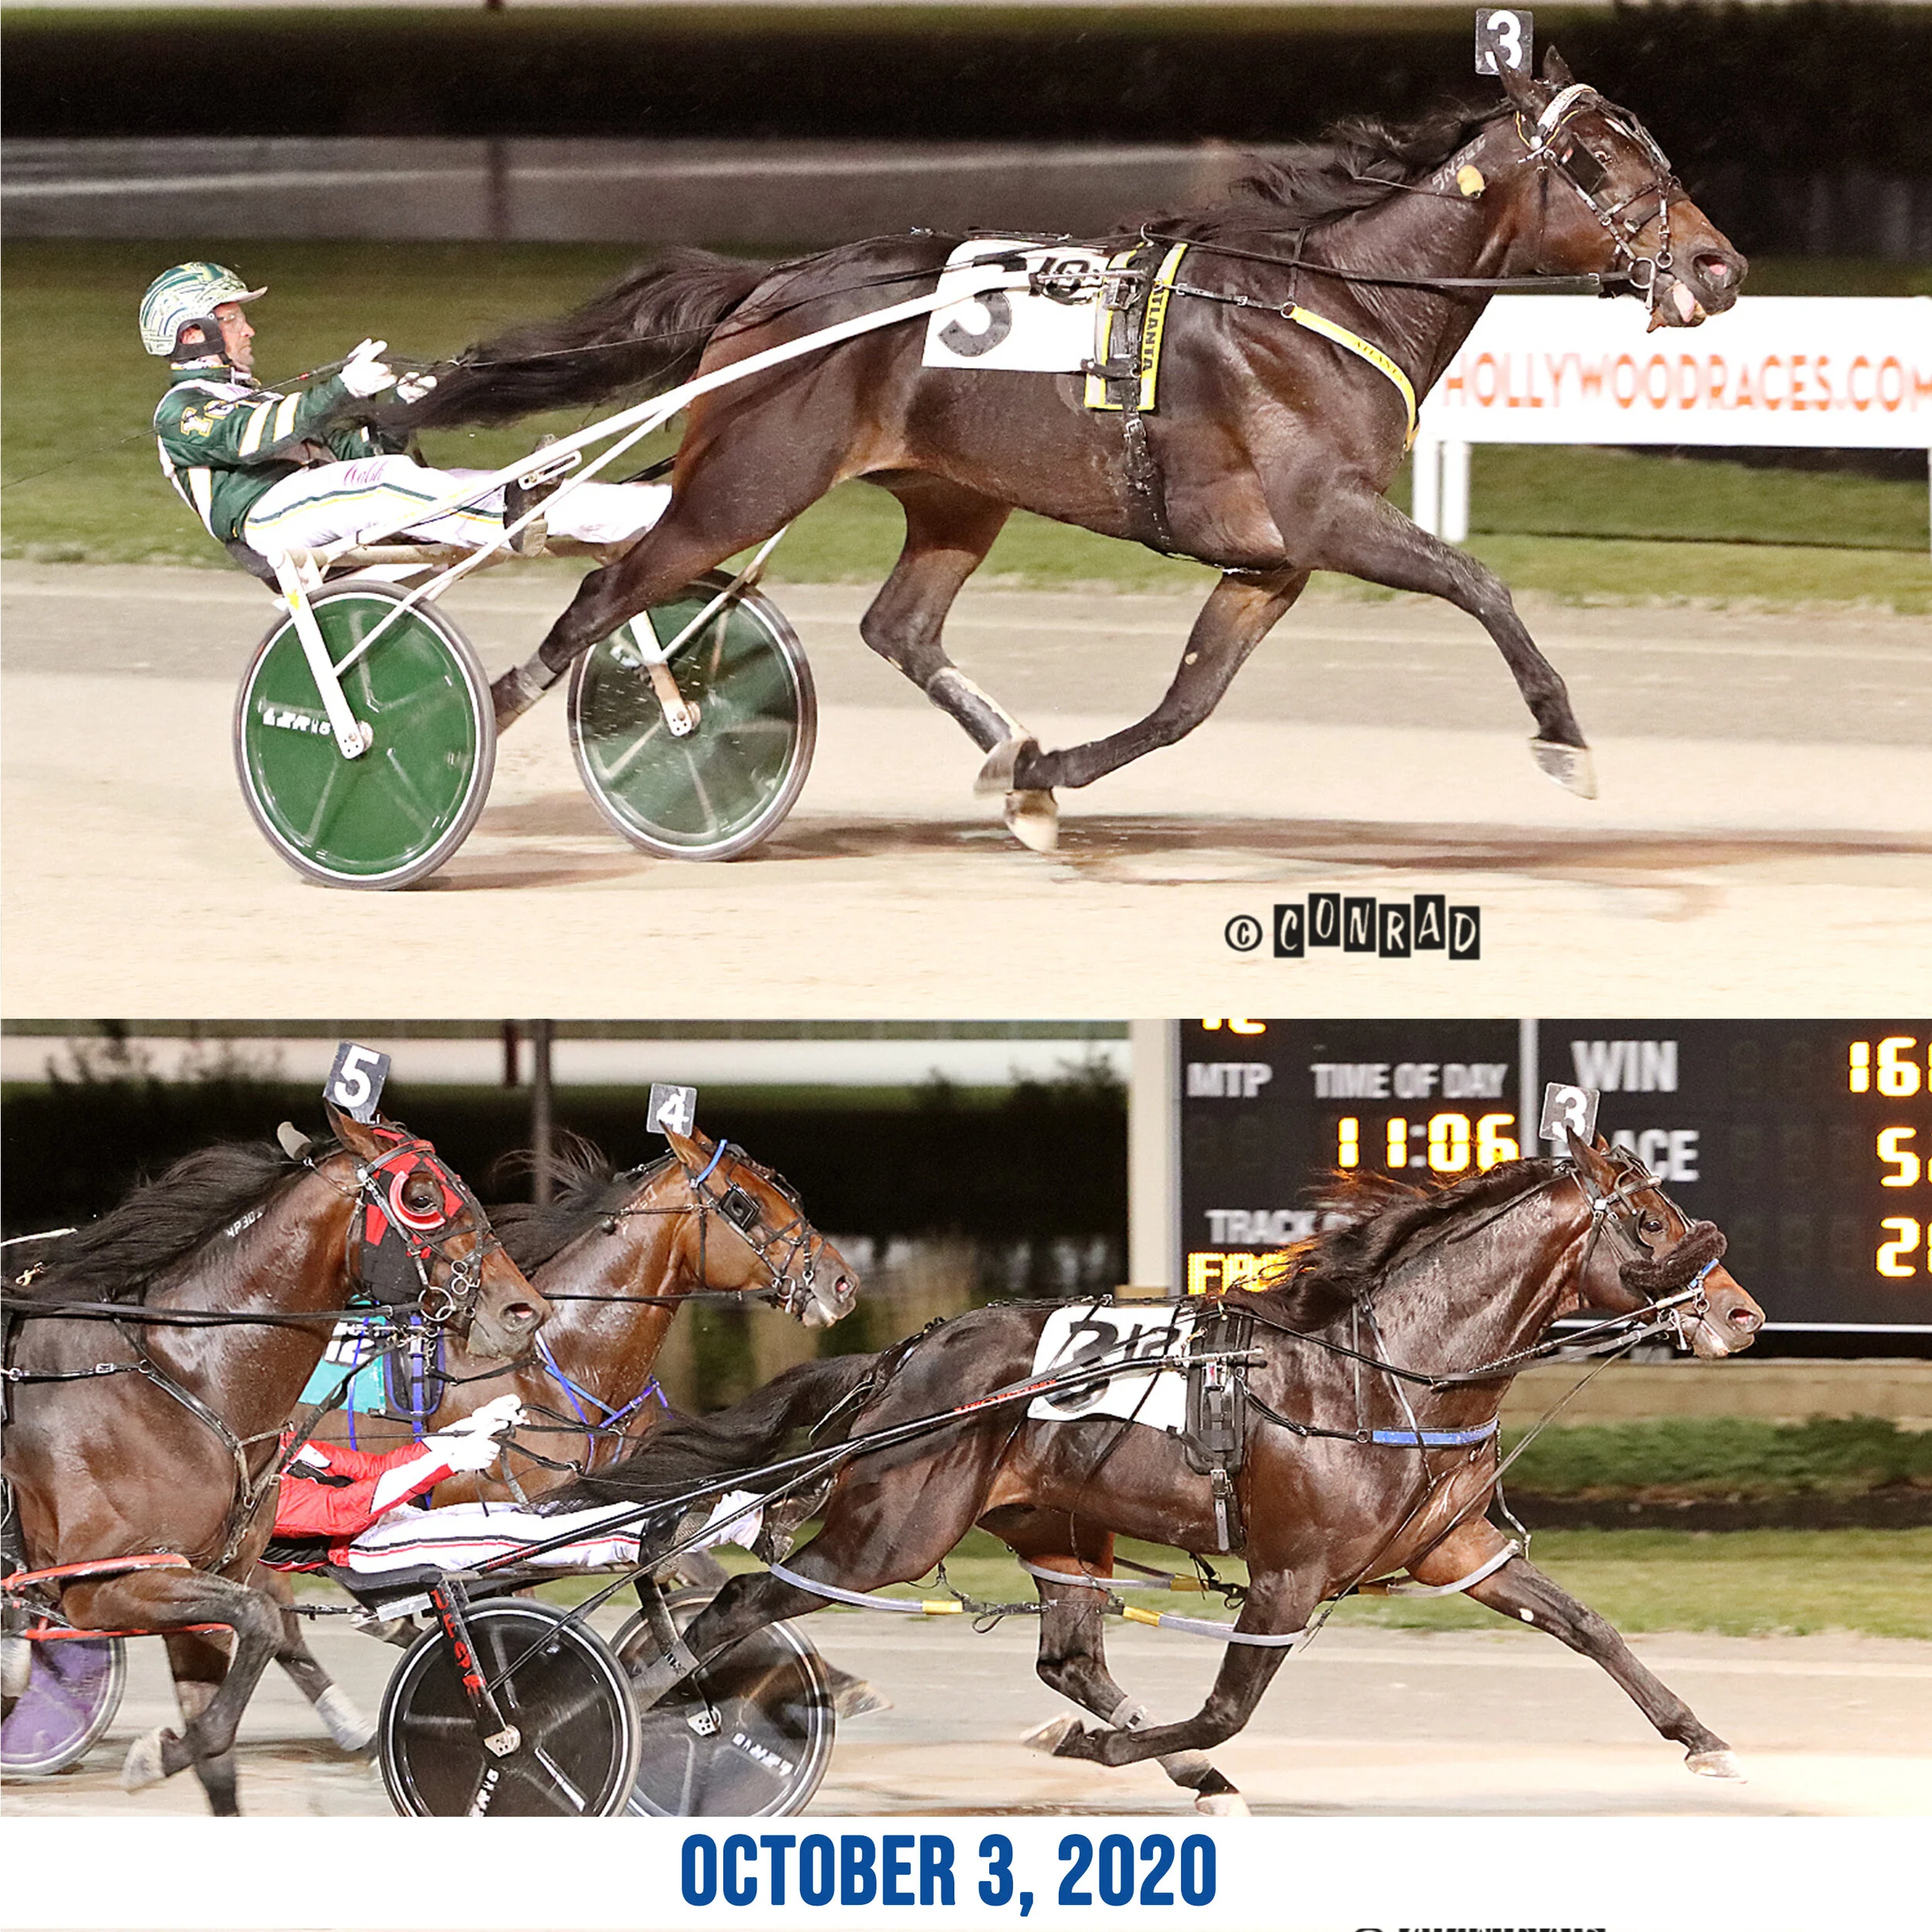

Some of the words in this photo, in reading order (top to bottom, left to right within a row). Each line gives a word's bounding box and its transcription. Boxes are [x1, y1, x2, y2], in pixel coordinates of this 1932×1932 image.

[1485, 10, 1522, 70] 3
[333, 1045, 379, 1108] 5
[1187, 1062, 1273, 1097] MTP
[1310, 1063, 1391, 1098] TIME
[1393, 1062, 1439, 1099] OF
[1443, 1063, 1509, 1098] DAY
[1570, 1040, 1679, 1093] WIN
[1849, 1037, 1932, 1097] 16
[655, 1087, 690, 1134] 4
[1552, 1087, 1588, 1144] 3
[1338, 1113, 1519, 1172] 11:06
[1876, 1127, 1932, 1187] 5
[1876, 1217, 1932, 1277] 2
